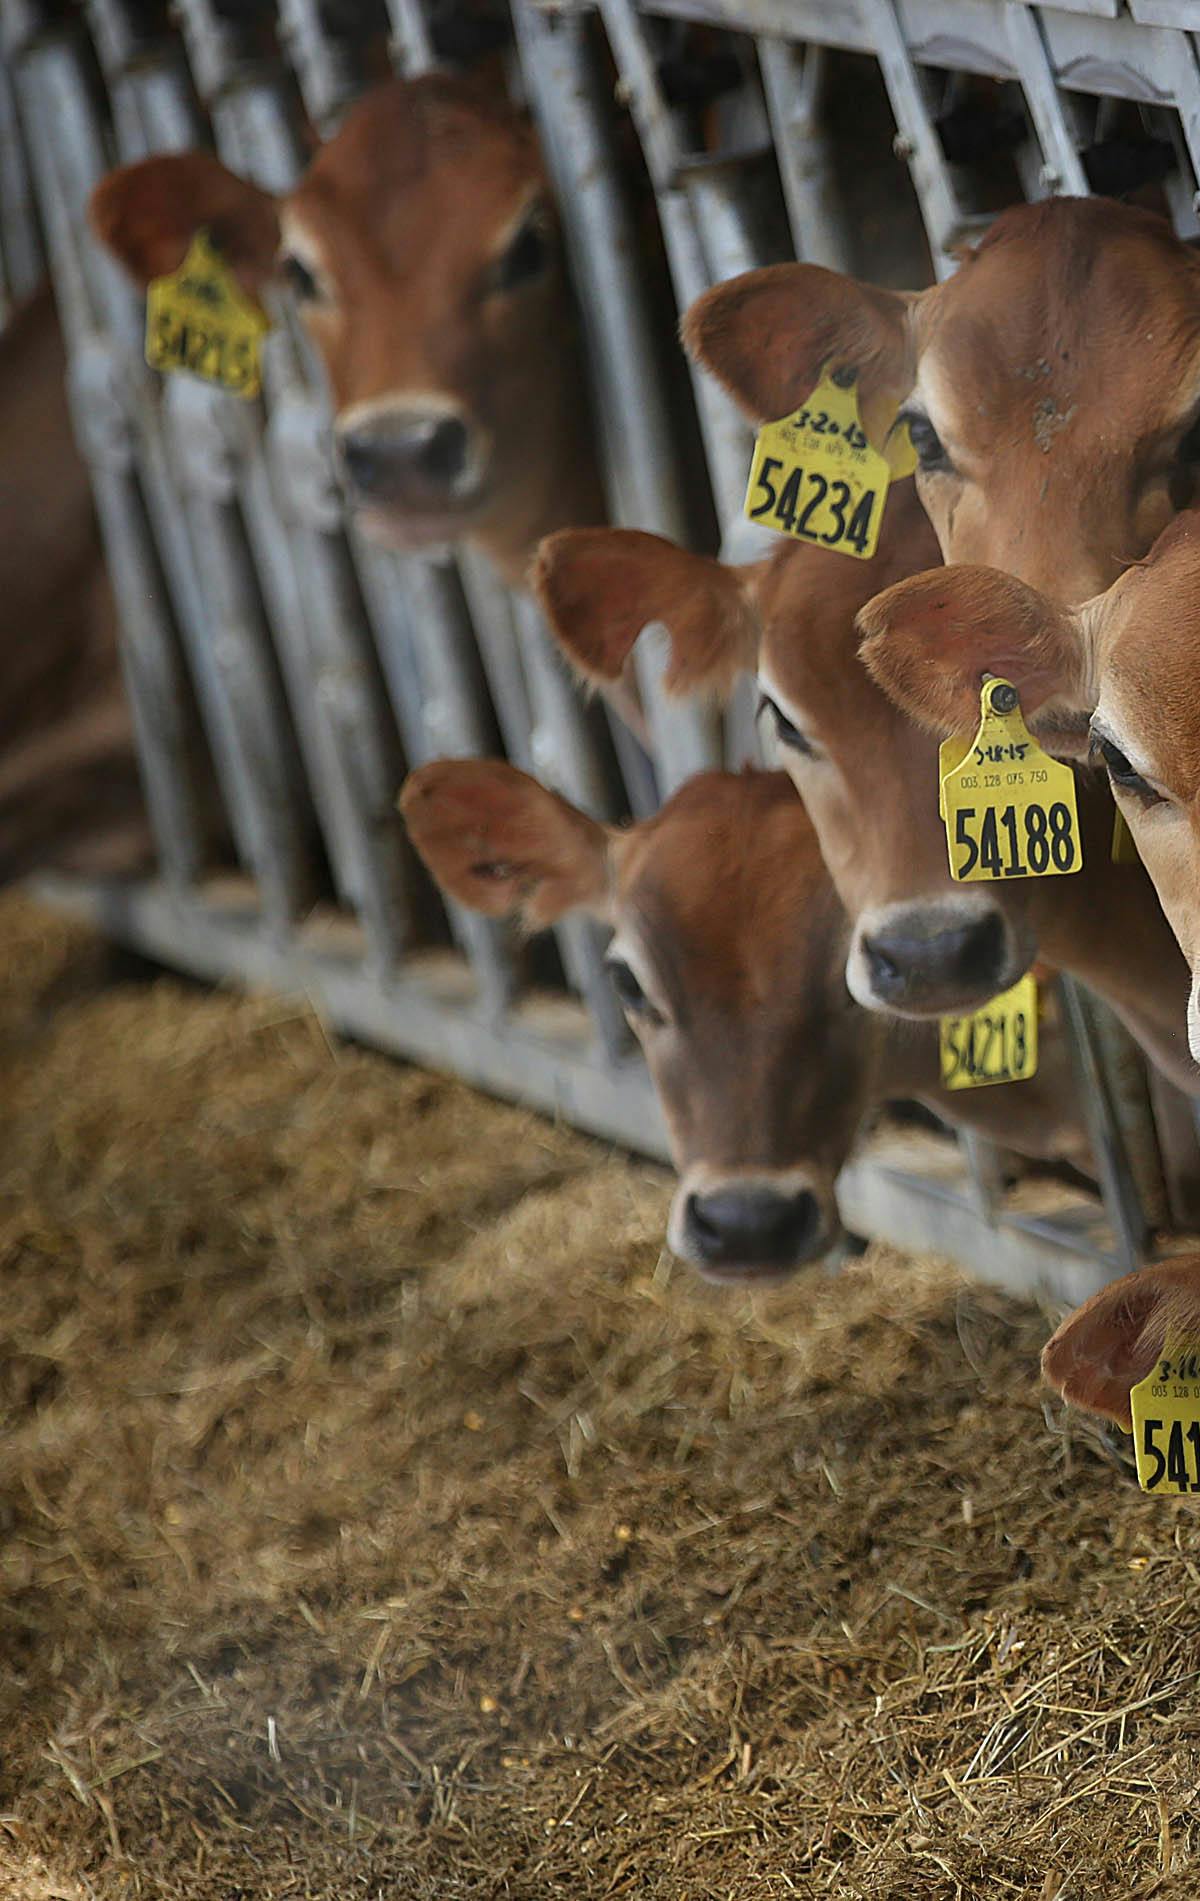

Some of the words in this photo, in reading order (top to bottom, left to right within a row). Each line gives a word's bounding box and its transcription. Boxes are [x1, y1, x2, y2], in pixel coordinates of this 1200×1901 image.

[751, 457, 876, 553] 54234
[960, 776, 978, 790] 003
[984, 774, 1001, 788] 128
[1029, 769, 1048, 784] 750
[956, 802, 1074, 880] 54188
